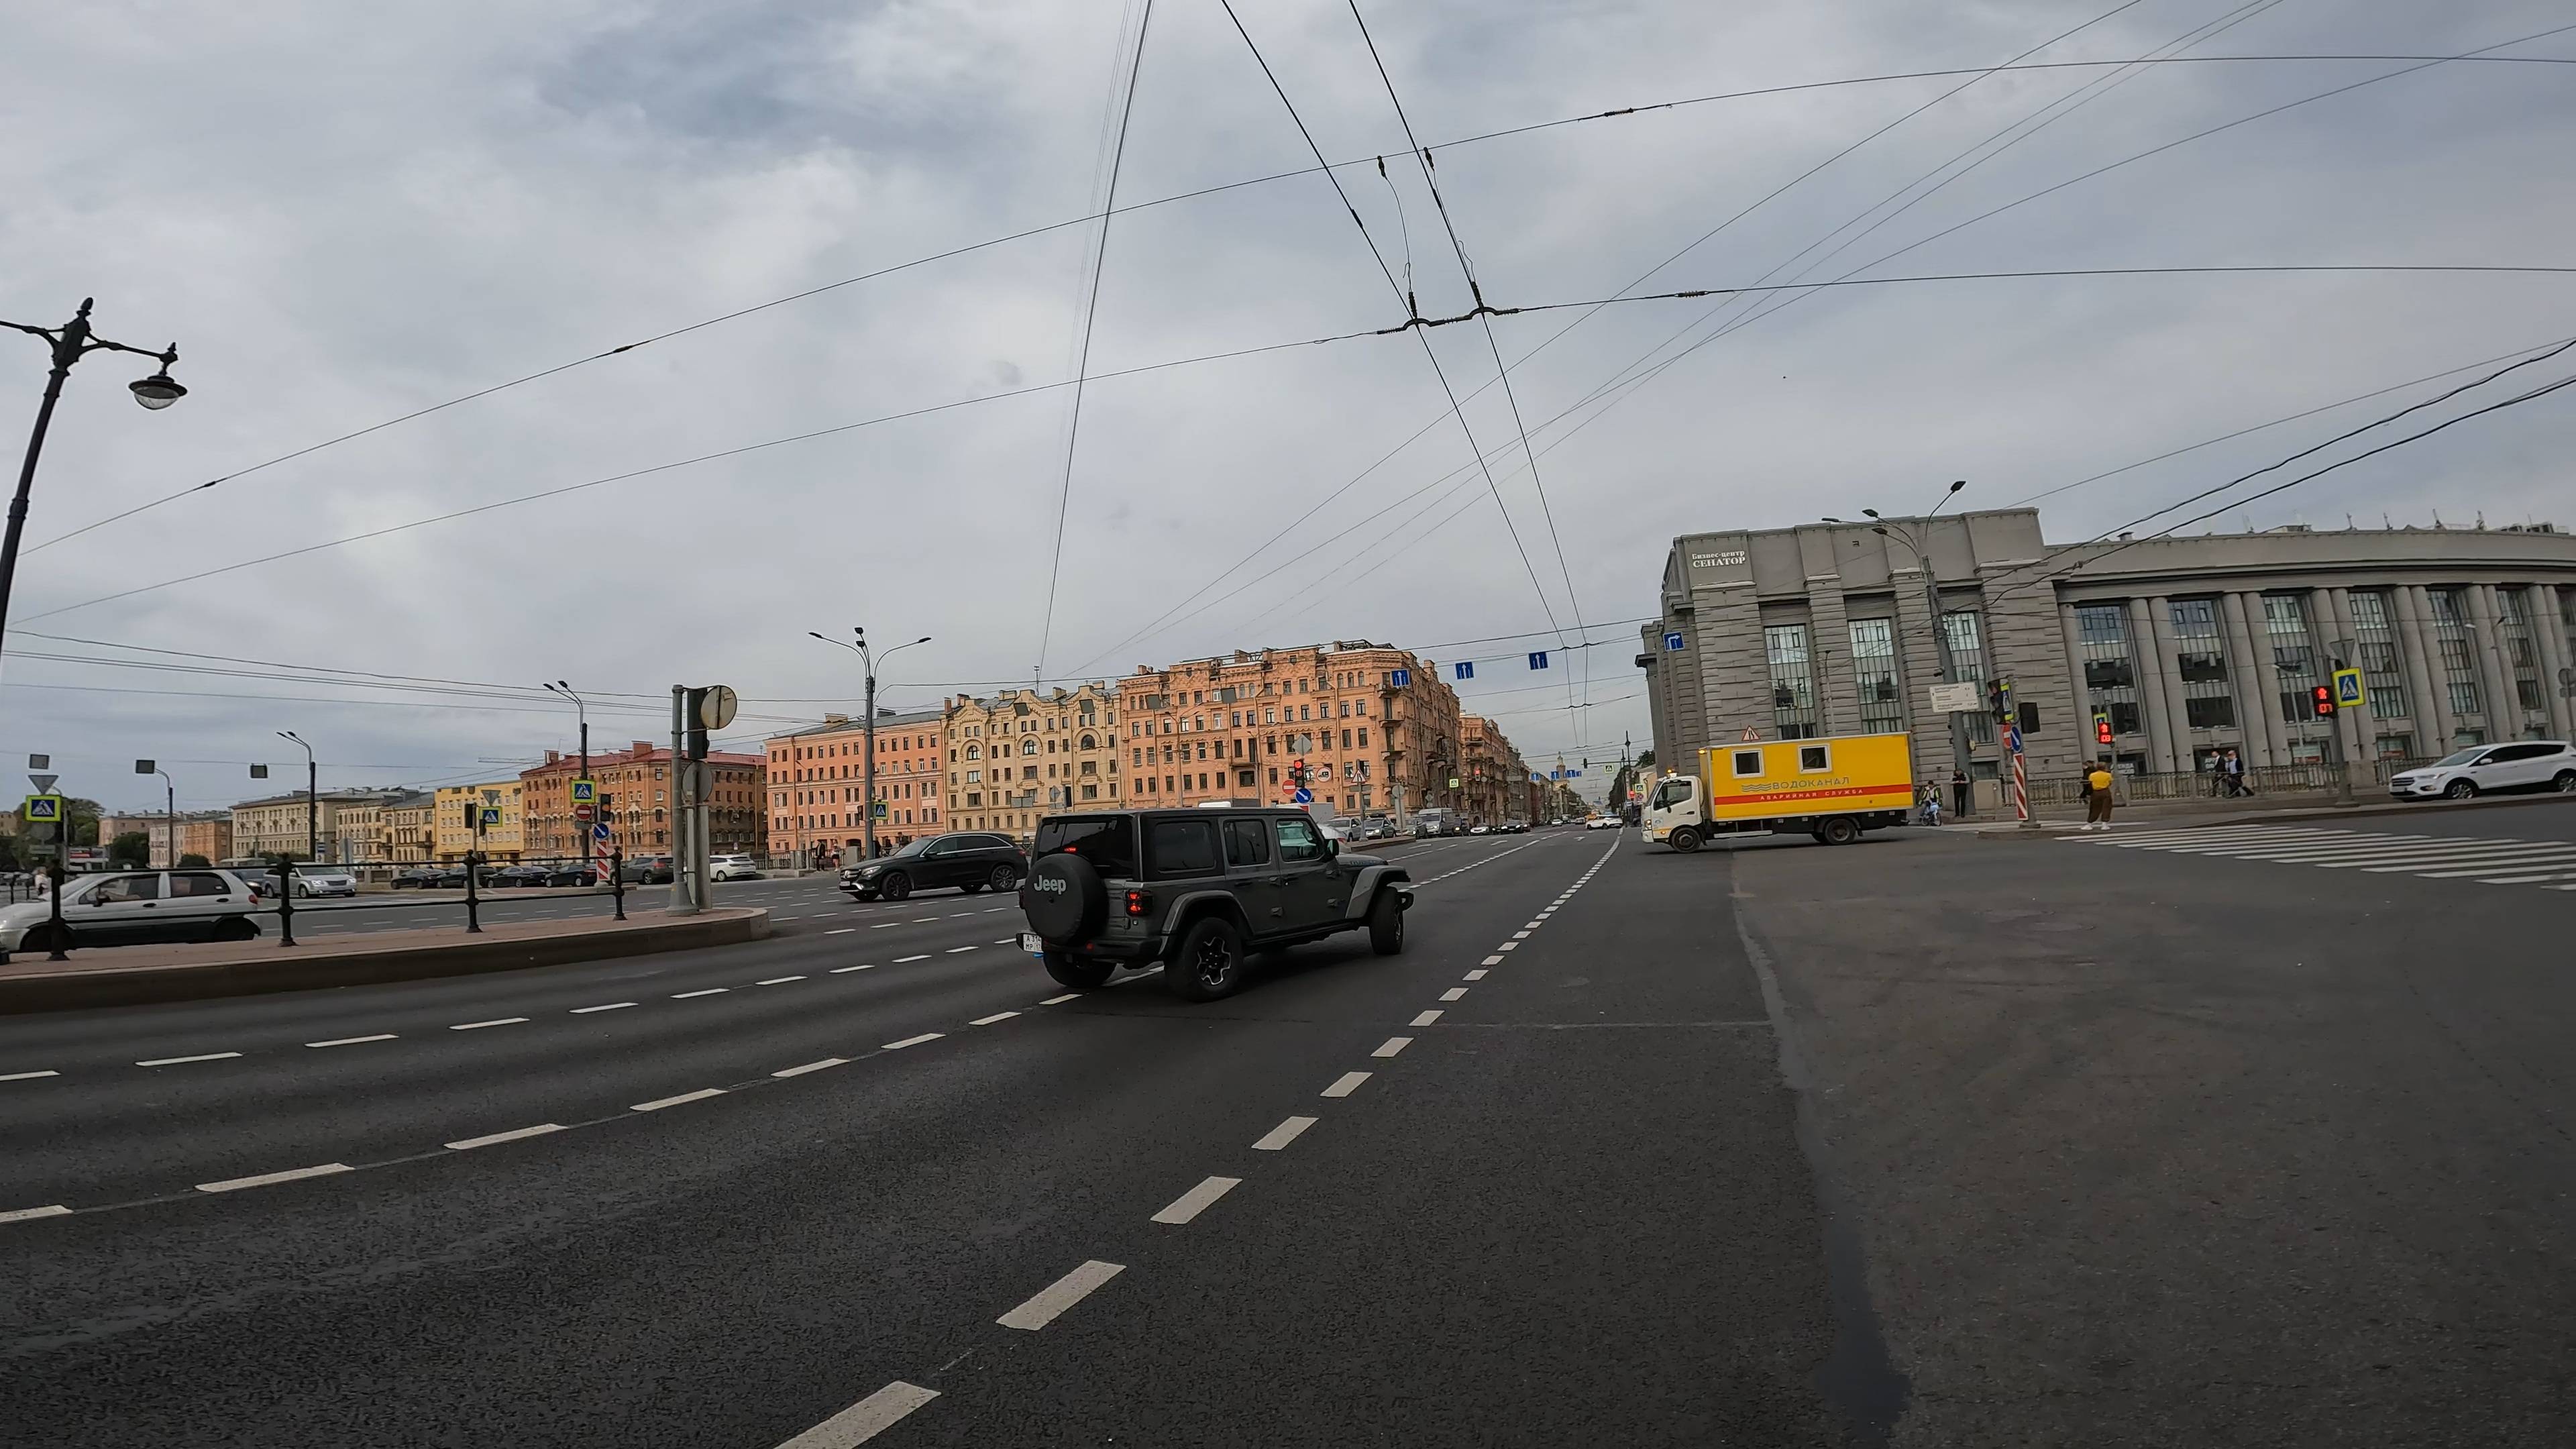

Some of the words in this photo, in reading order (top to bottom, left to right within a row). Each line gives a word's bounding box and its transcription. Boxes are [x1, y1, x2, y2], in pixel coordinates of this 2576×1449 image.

[1692, 551, 1745, 559] Бизнес-центр
[1693, 557, 1746, 568] СЕНАТОР
[1773, 777, 1849, 790] ВОДОКАНАЛ
[1760, 792, 1817, 801] АВАРИЙНАЯ
[1034, 874, 1067, 895] Jeep
